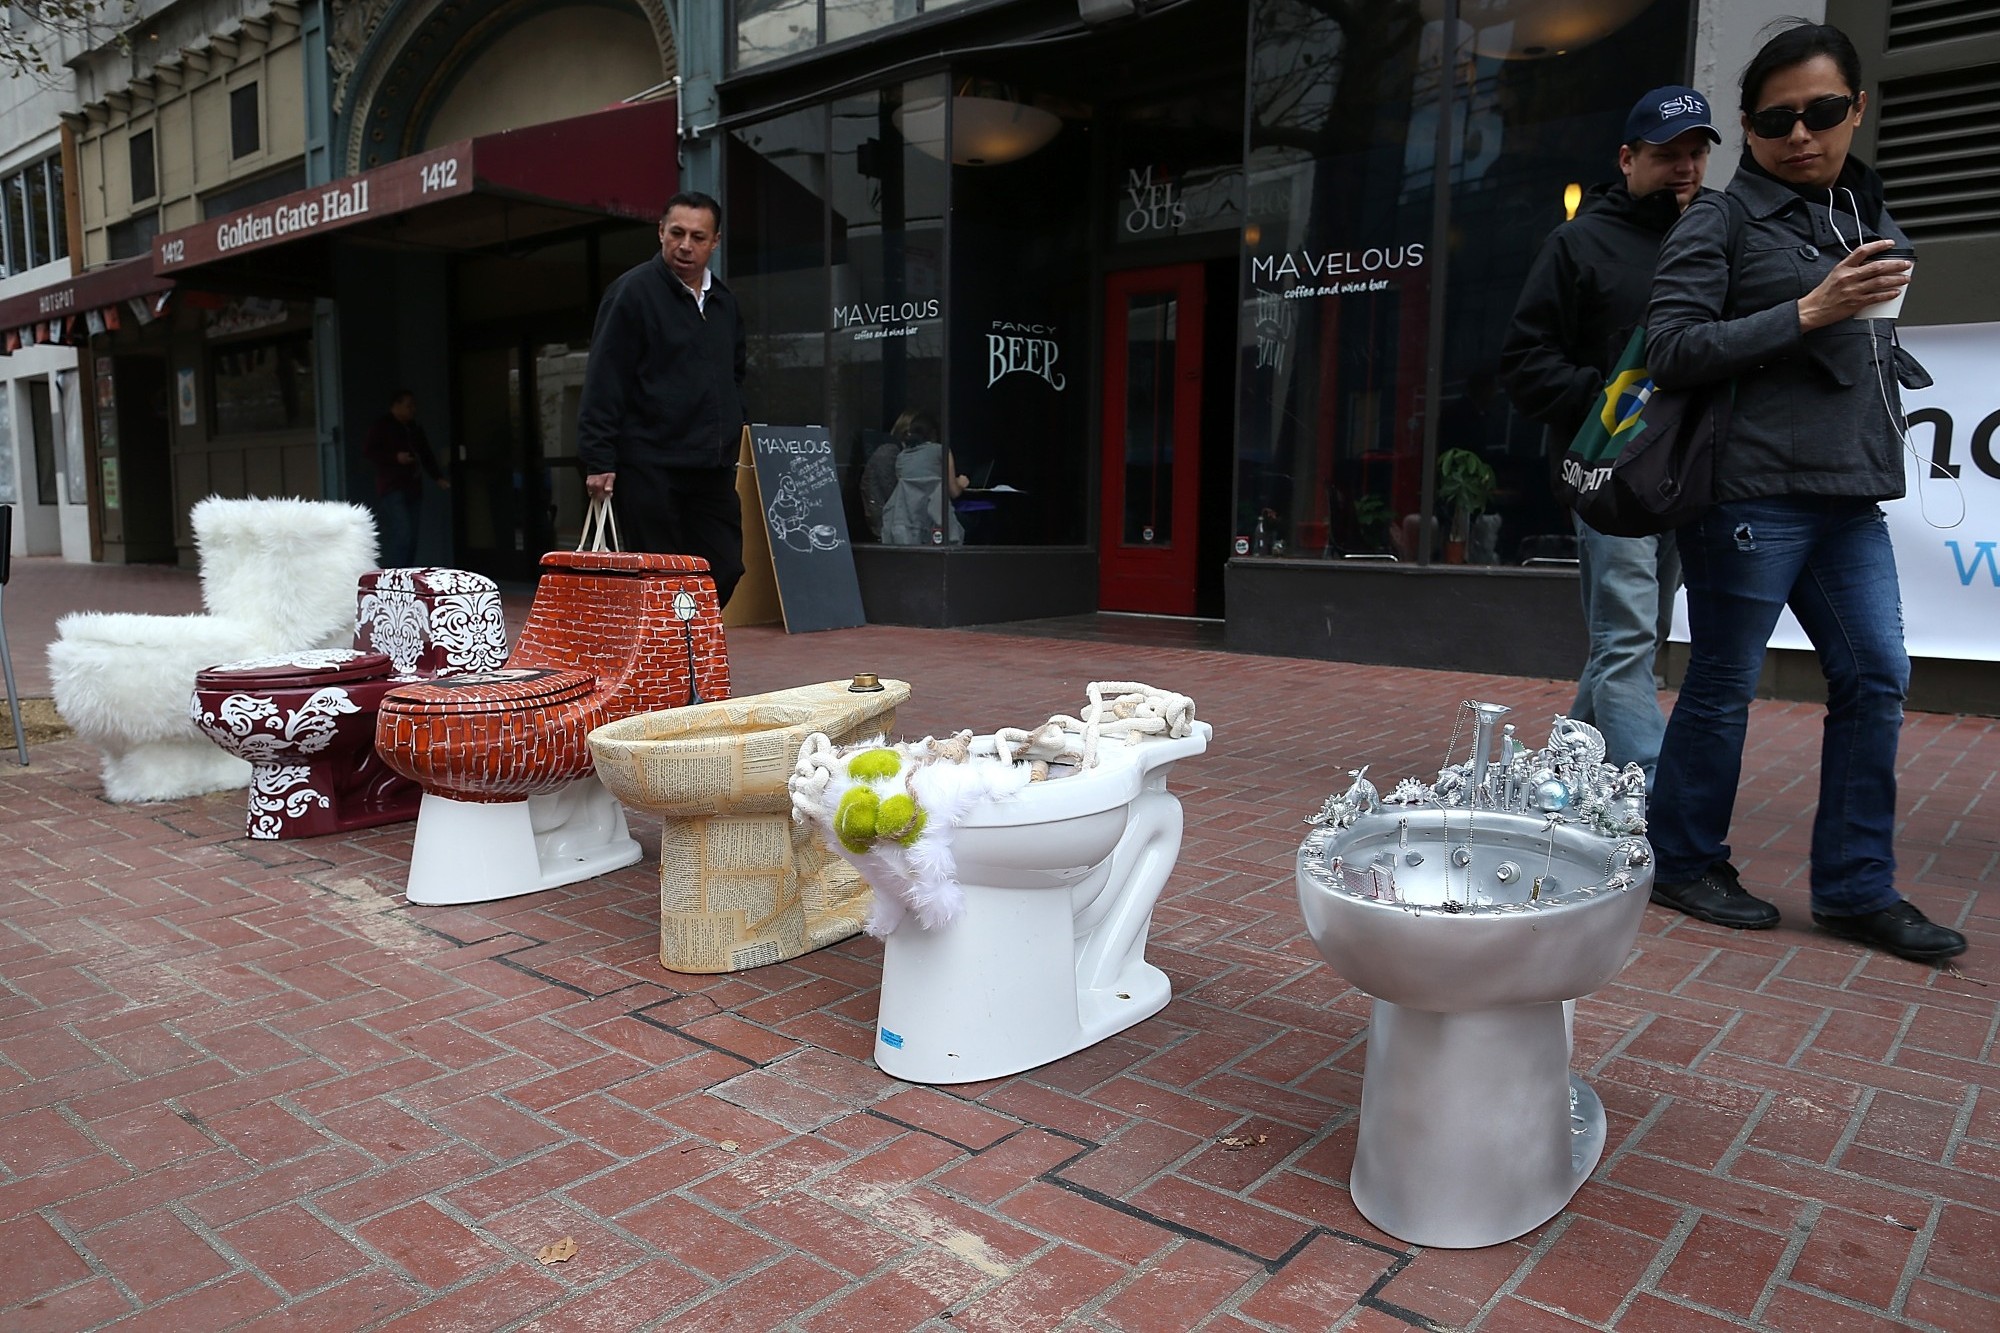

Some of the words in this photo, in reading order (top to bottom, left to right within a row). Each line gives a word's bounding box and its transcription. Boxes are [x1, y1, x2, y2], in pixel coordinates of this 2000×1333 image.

[420, 158, 458, 194] 1412
[217, 212, 273, 252] Golden
[275, 201, 319, 235] Gate
[322, 180, 369, 222] Hall
[1126, 202, 1187, 234] OUS
[161, 239, 185, 264] 1412
[1251, 243, 1426, 284] MAVELOUS
[39, 288, 74, 314] HOTSPOT
[1283, 284, 1316, 300] coffee
[1316, 282, 1340, 297] and
[1341, 281, 1367, 294] wine
[1368, 278, 1390, 292] bar
[833, 299, 940, 329] MAVELOUS
[992, 320, 1057, 335] FANCY
[853, 329, 874, 341] coffee
[874, 328, 888, 339] and
[888, 327, 905, 337] wine
[905, 326, 919, 336] bar
[985, 333, 1066, 391] BEER
[757, 437, 832, 455] MAVELOUS
